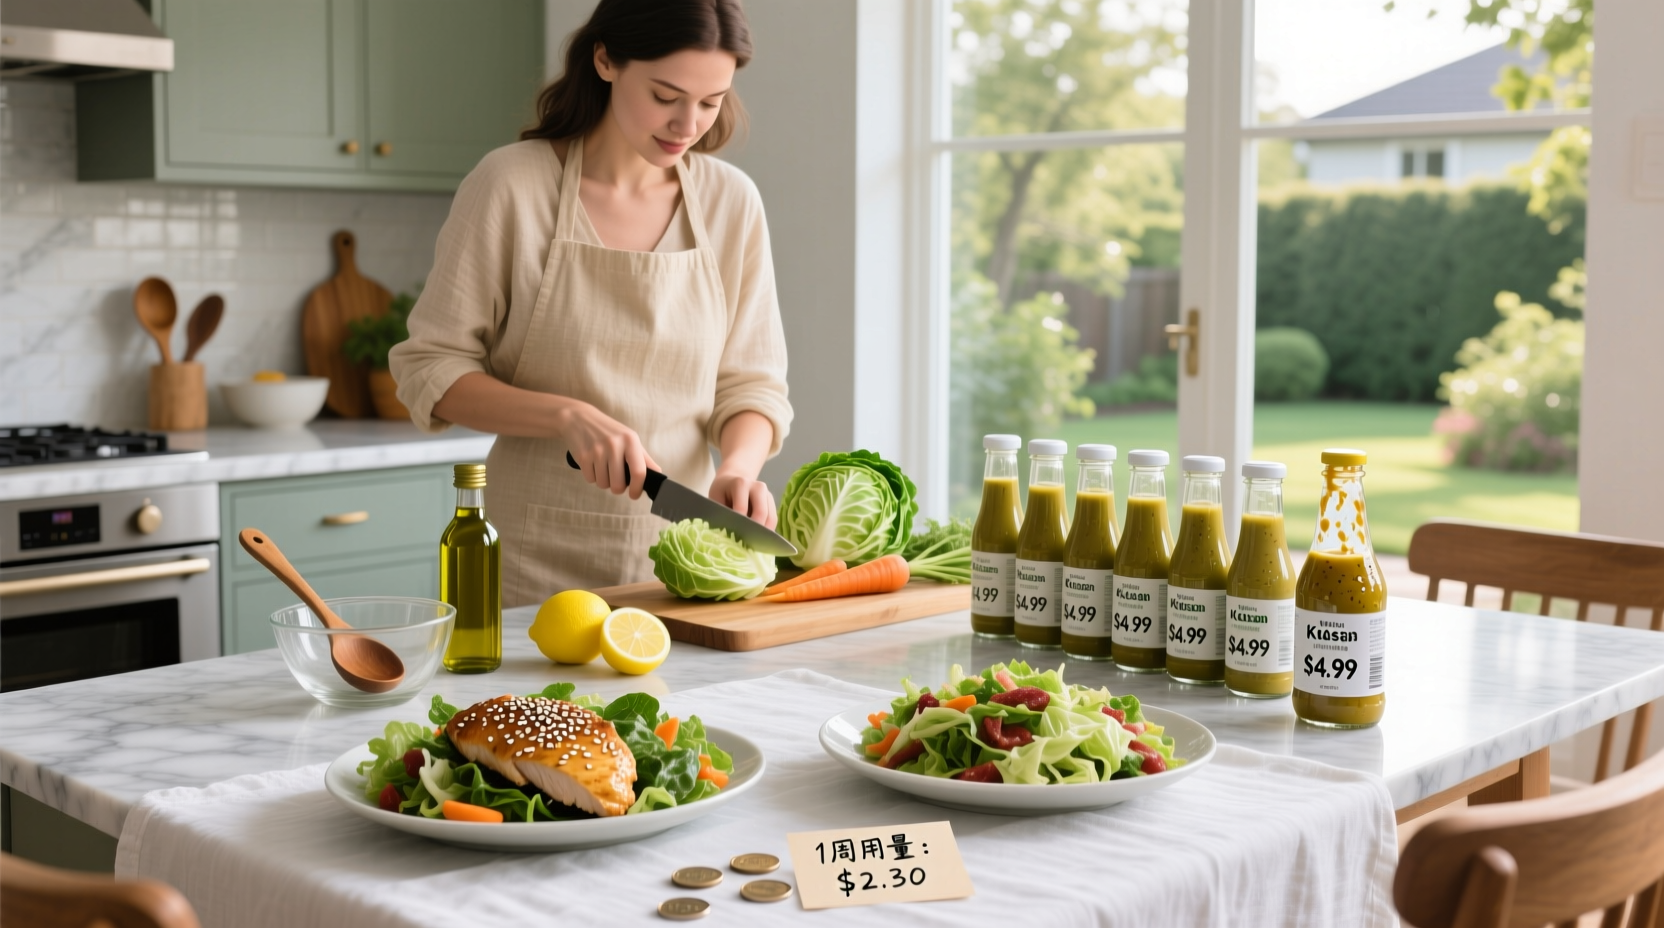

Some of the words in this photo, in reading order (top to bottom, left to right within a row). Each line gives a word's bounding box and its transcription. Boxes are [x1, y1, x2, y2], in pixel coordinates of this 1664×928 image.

[1064, 603, 1097, 622] $4.99
[1114, 612, 1152, 633] $4.99
[1168, 623, 1207, 644] $4.99
[1228, 635, 1270, 657] $4.99
[1303, 654, 1358, 680] $4.99
[815, 833, 929, 865] 1周用量：
[837, 868, 926, 897] $2.30
